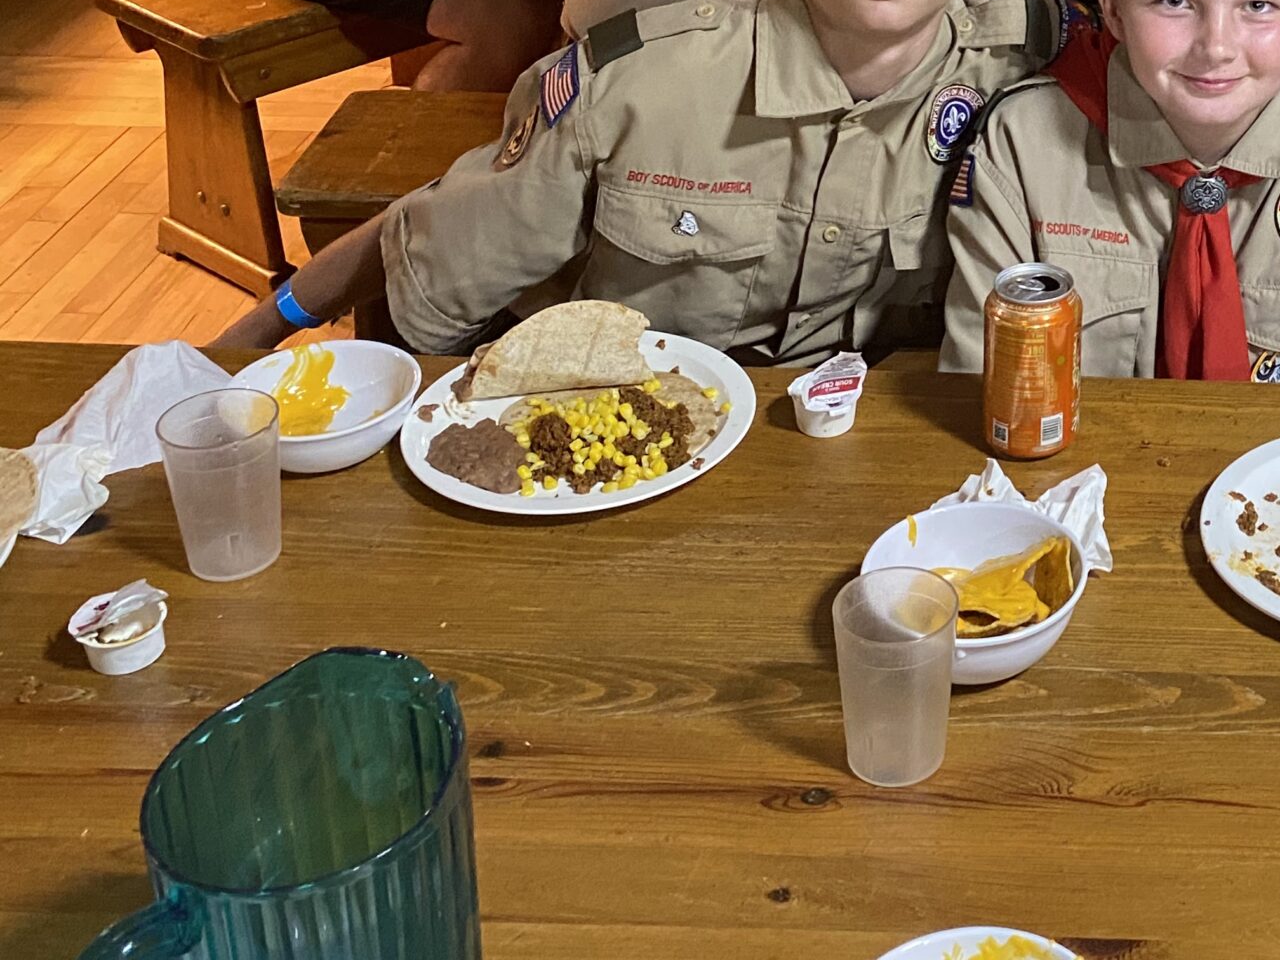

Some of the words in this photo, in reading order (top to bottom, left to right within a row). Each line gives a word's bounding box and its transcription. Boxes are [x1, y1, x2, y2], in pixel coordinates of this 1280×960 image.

[627, 170, 650, 184] BOY
[651, 174, 695, 191] SCOUTS
[710, 181, 752, 194] AMERICA
[1046, 223, 1081, 236] SCOUTS
[1091, 227, 1130, 245] AMERICA
